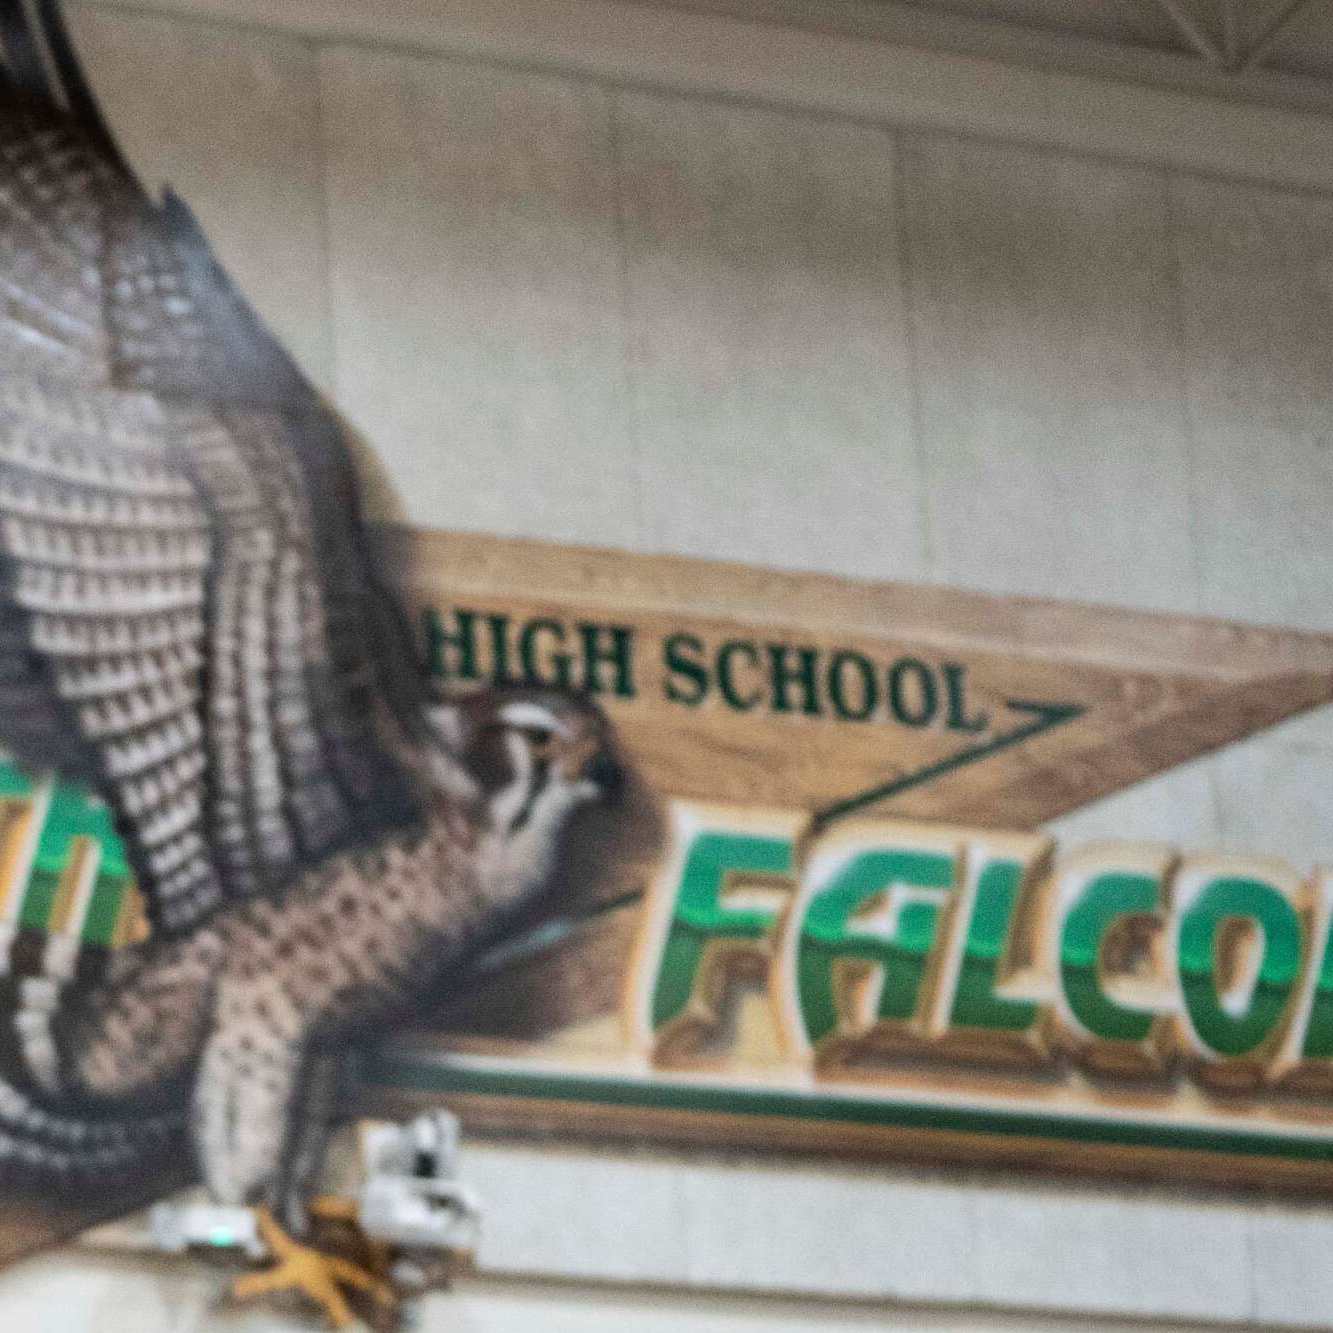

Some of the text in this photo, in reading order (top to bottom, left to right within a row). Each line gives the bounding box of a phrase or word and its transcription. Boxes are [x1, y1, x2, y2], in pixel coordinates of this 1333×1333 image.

[423, 607, 637, 700] HIGH
[662, 633, 989, 734] SCHOOL
[631, 812, 1333, 1072] FALCO
